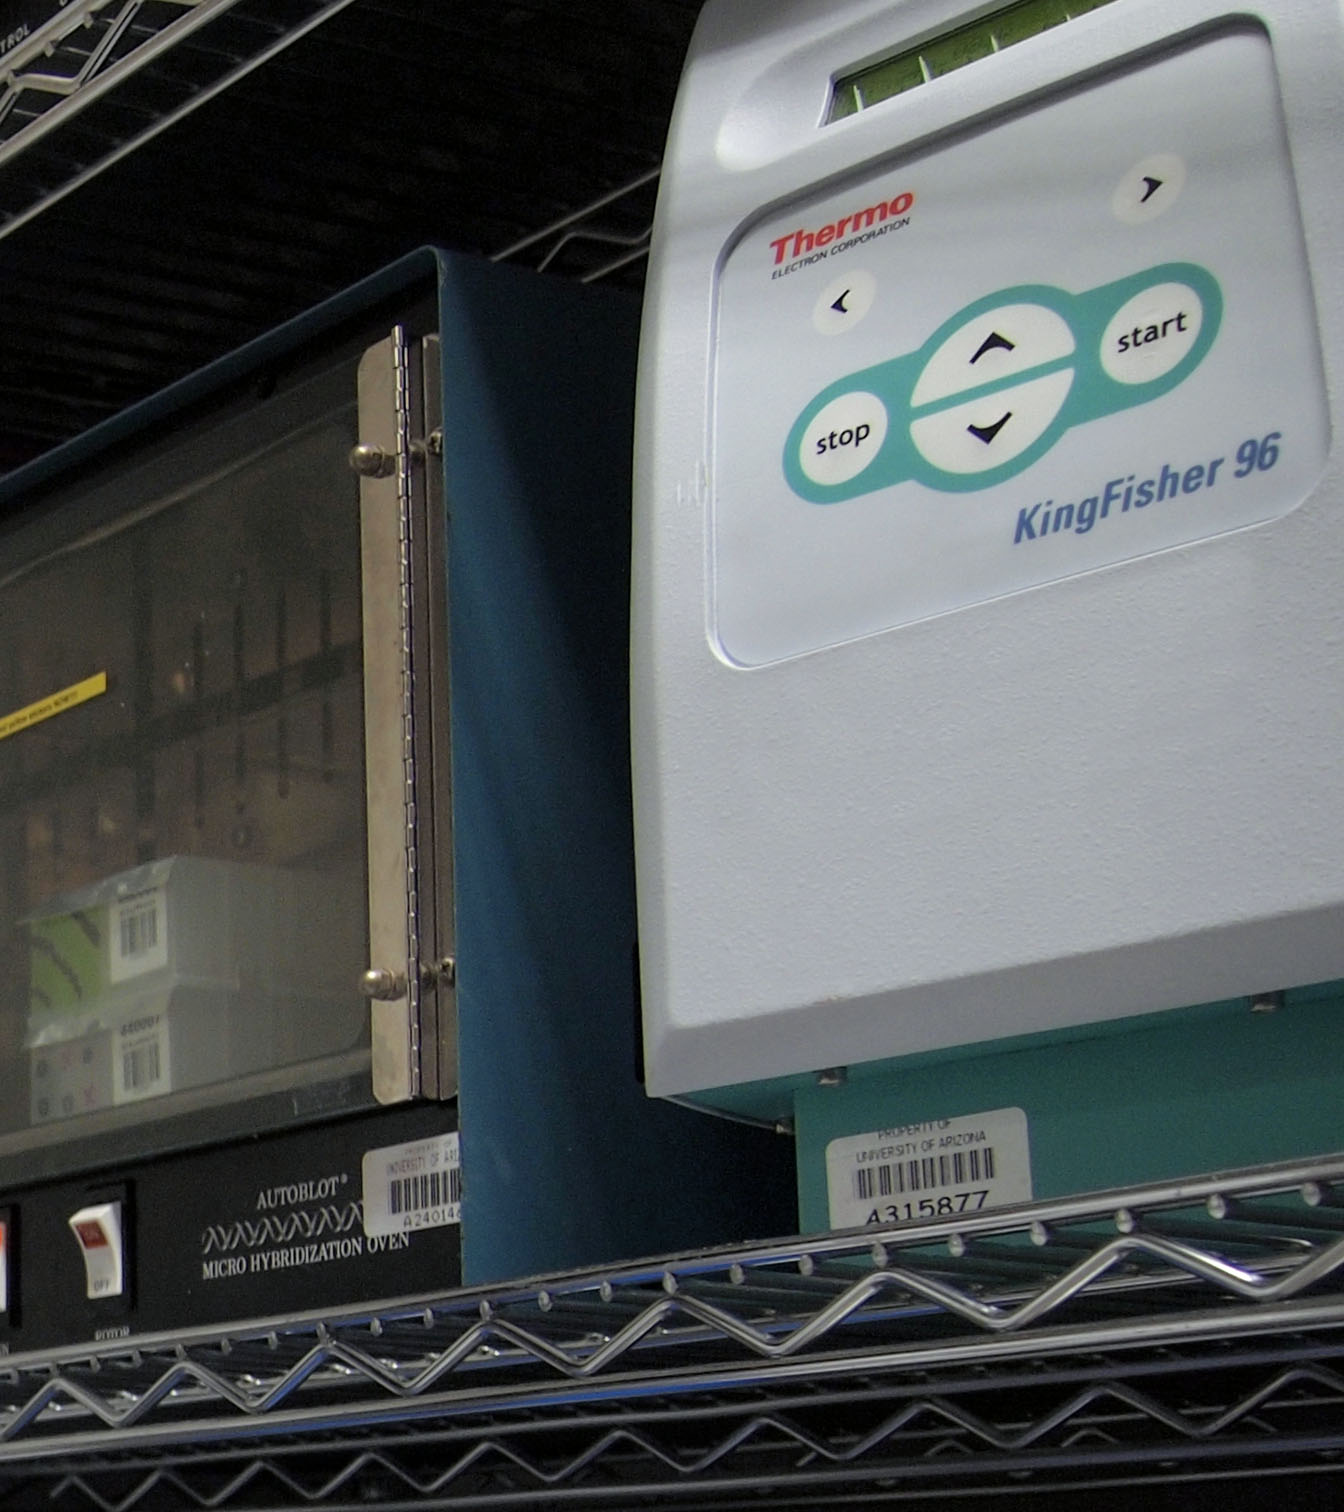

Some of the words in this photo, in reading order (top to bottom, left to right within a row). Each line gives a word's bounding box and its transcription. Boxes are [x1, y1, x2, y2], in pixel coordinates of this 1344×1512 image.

[770, 192, 915, 264] Thermo
[771, 250, 828, 280] ELECTRON
[830, 217, 911, 256] CORPORATION
[1117, 311, 1188, 354] start
[815, 420, 871, 456] stop
[1013, 455, 1224, 544] KingFisher
[1234, 432, 1283, 480] 96
[856, 1143, 917, 1164] UNIVERSITY
[920, 1138, 936, 1153] OF
[938, 1130, 987, 1148] ARIZONA
[866, 1190, 990, 1225] A315877
[202, 1256, 247, 1280] MICRO
[250, 1236, 363, 1273] HYBRIDIZATION
[367, 1231, 410, 1254] OVEN
